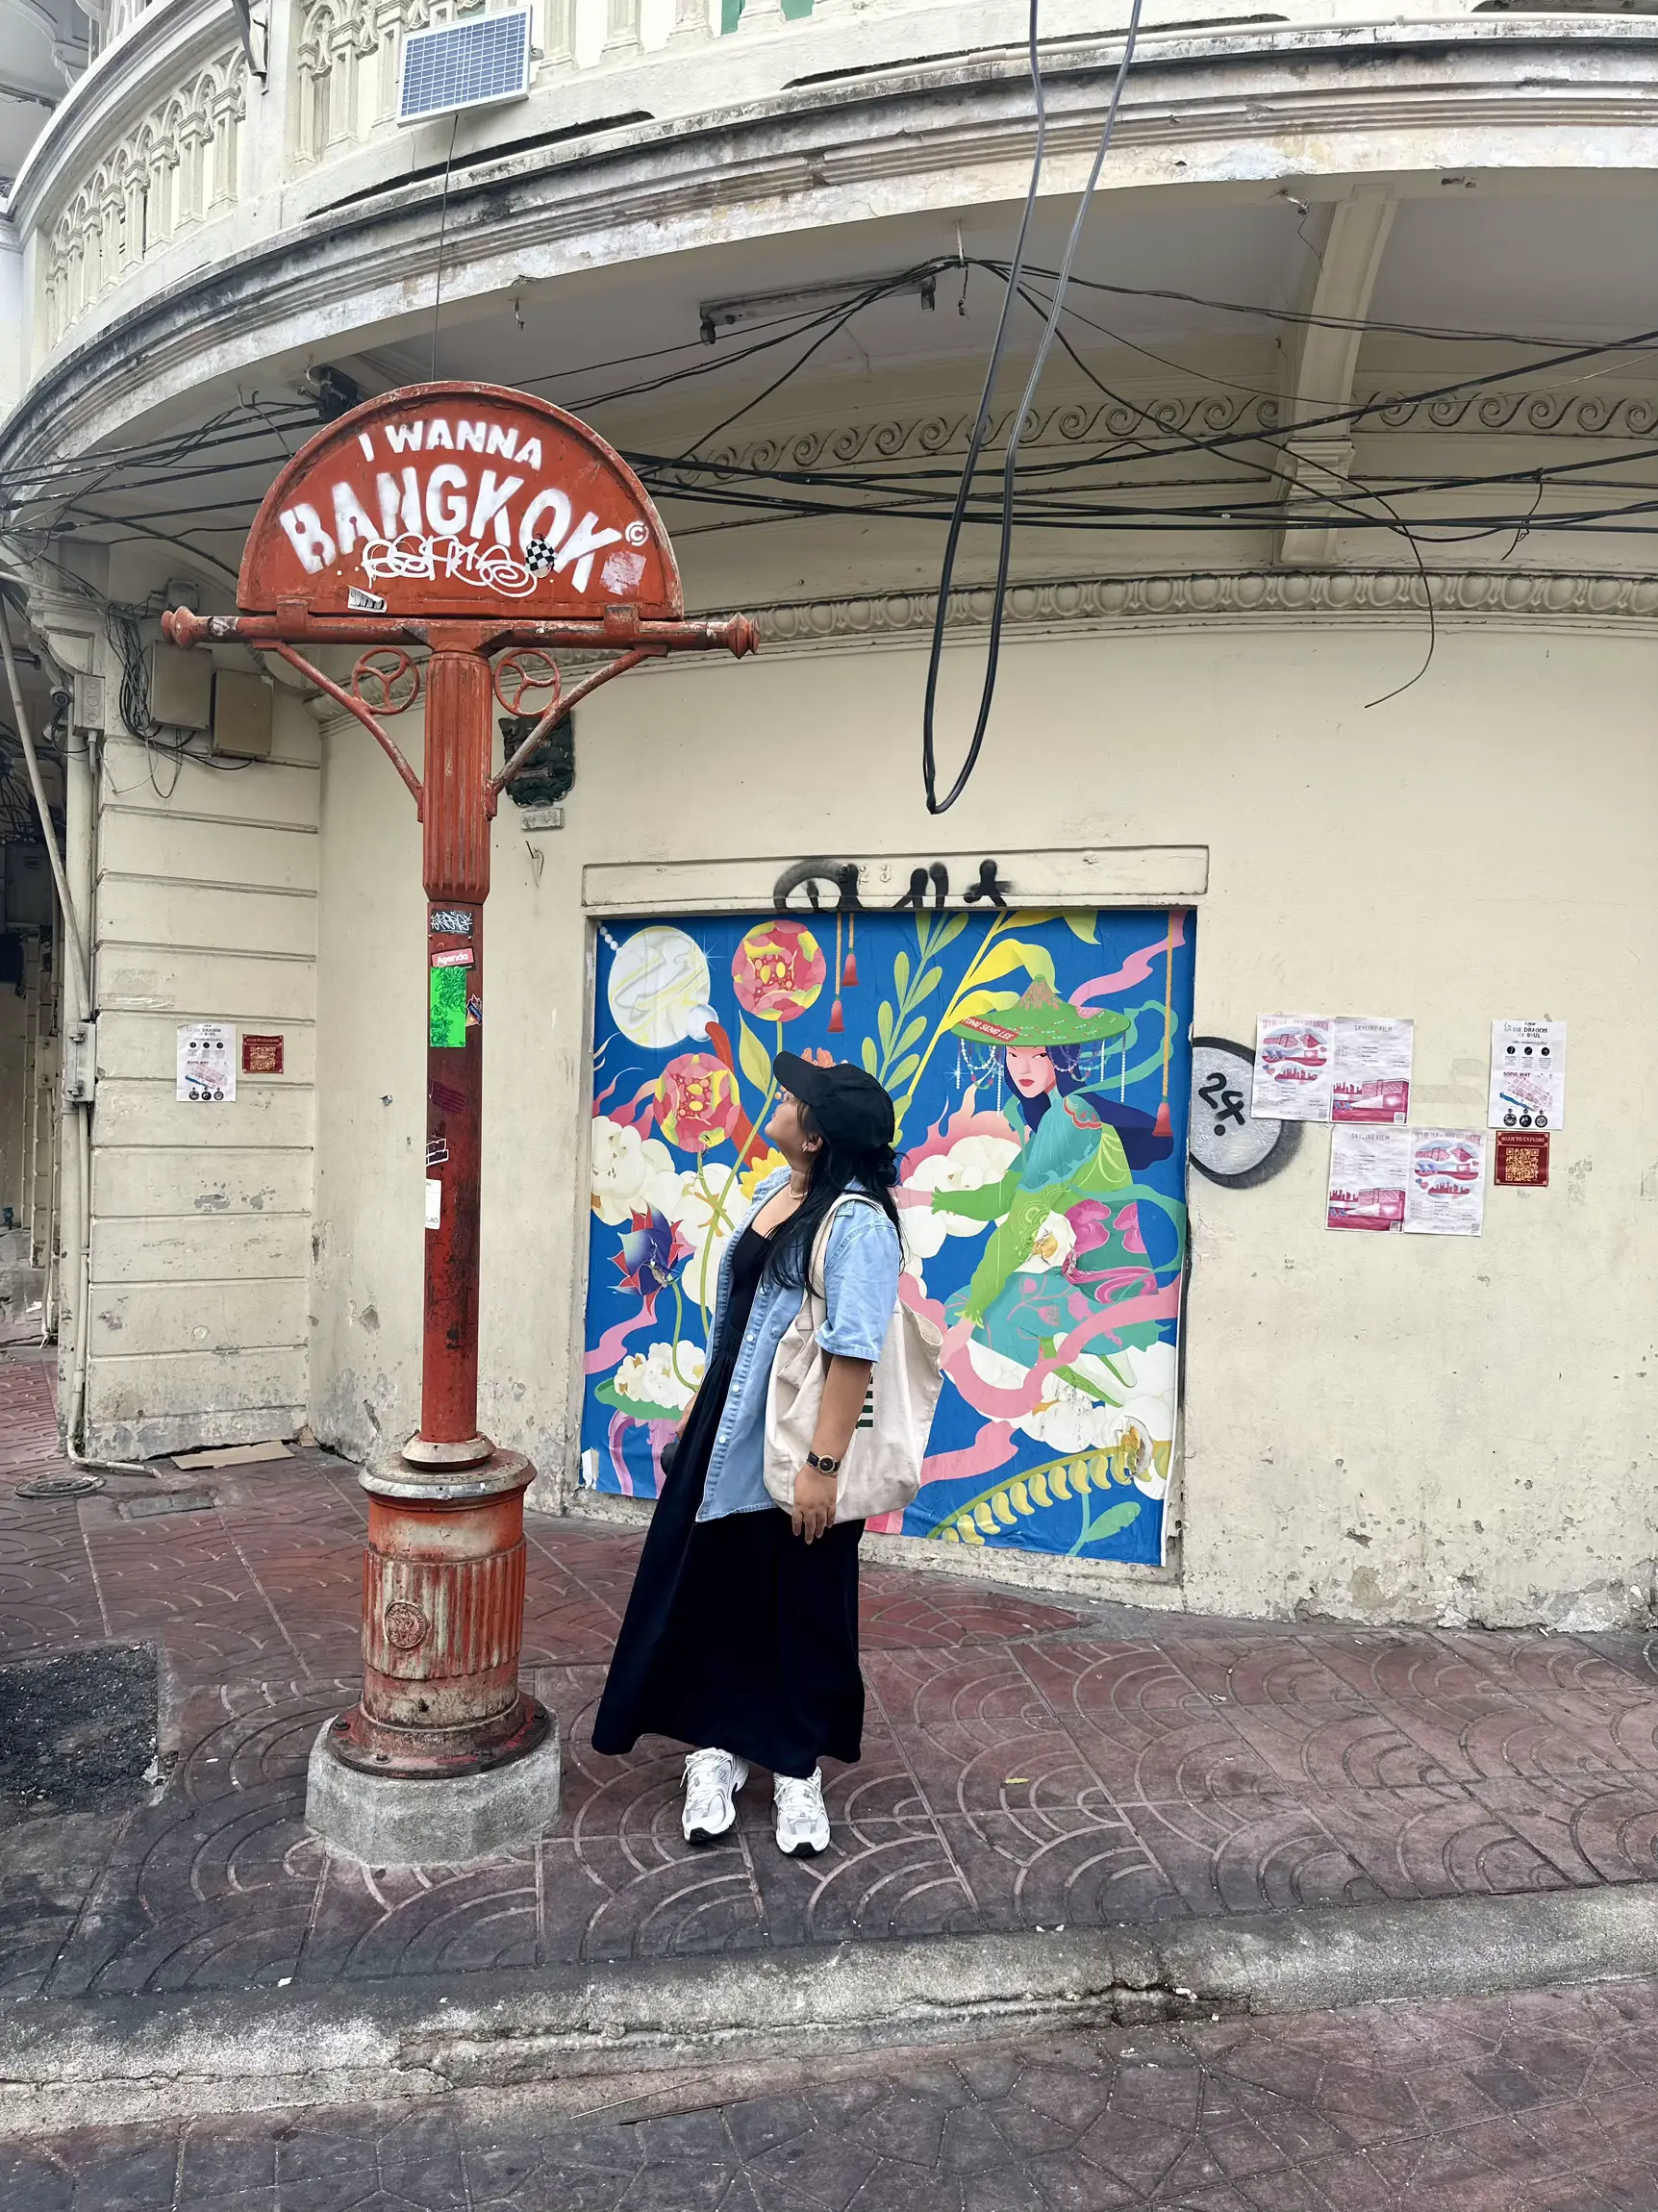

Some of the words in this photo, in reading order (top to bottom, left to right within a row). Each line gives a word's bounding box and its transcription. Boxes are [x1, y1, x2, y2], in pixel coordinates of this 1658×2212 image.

[358, 432, 375, 463] I
[385, 419, 542, 471] WANNA
[280, 464, 623, 594] BANGKOK
[437, 952, 468, 966] Agenda
[963, 1018, 981, 1028] TONG
[980, 1023, 999, 1035] SENG
[998, 1030, 1014, 1041] LEE
